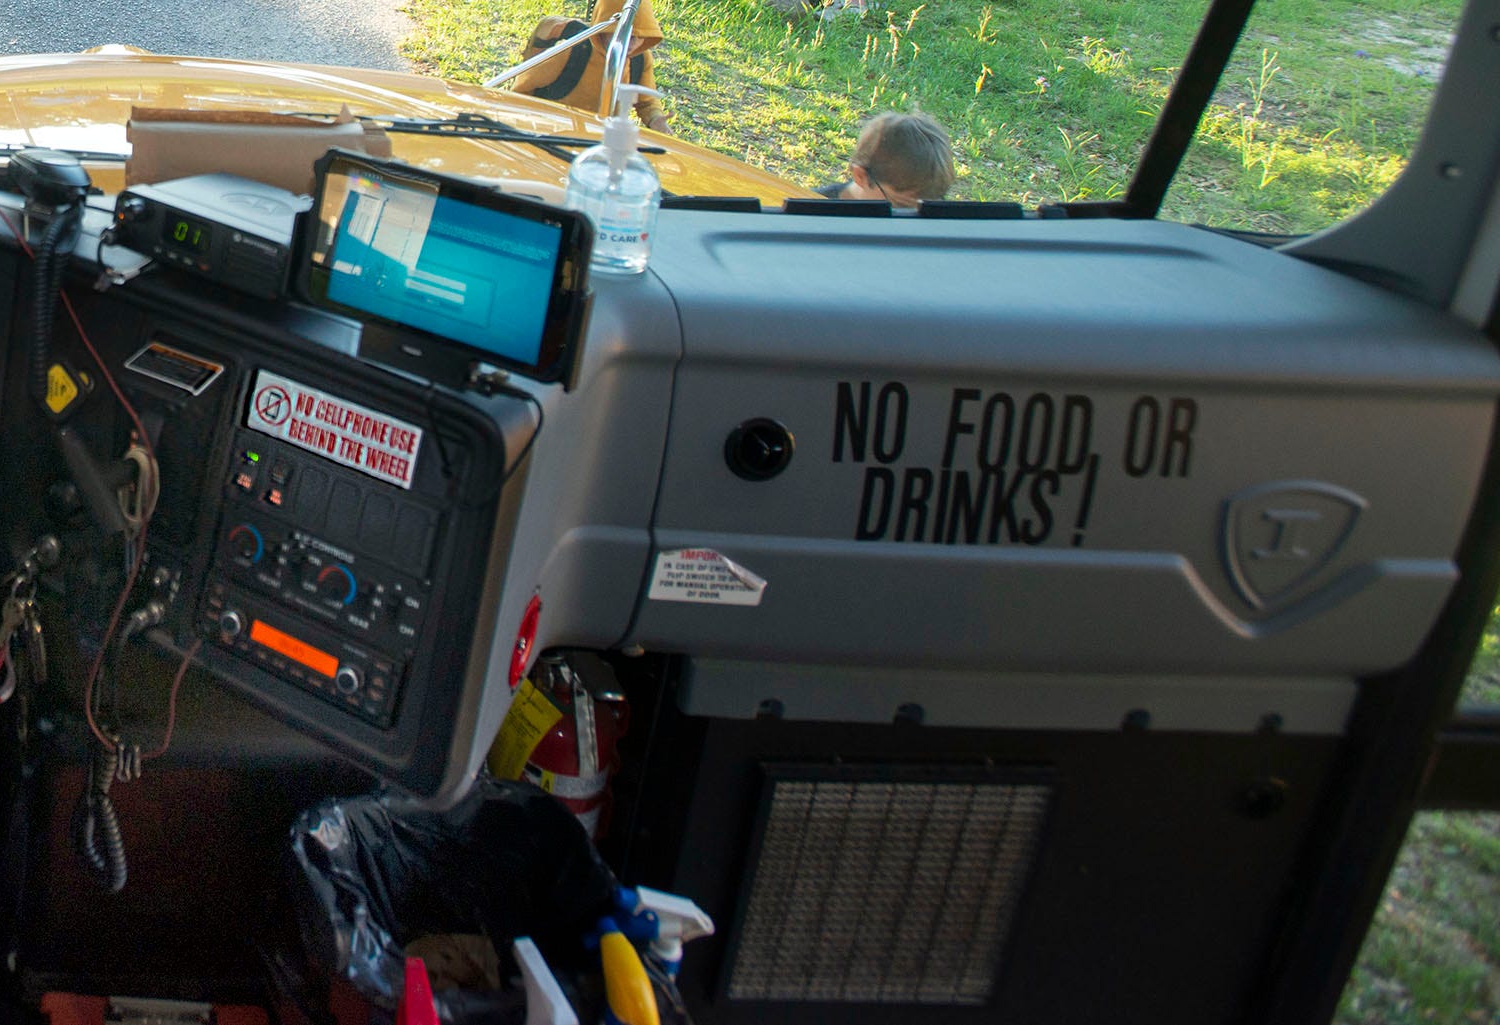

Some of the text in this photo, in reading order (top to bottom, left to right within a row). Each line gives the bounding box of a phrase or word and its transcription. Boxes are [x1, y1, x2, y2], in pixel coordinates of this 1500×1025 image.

[174, 222, 201, 245] 01
[610, 234, 638, 244] CARE
[289, 418, 411, 482] BEHIND THE WHEEL
[296, 392, 417, 455] NO CELLPHONE USE
[831, 381, 1198, 478] NO FOOD OR
[854, 453, 1100, 547] DRINKS!
